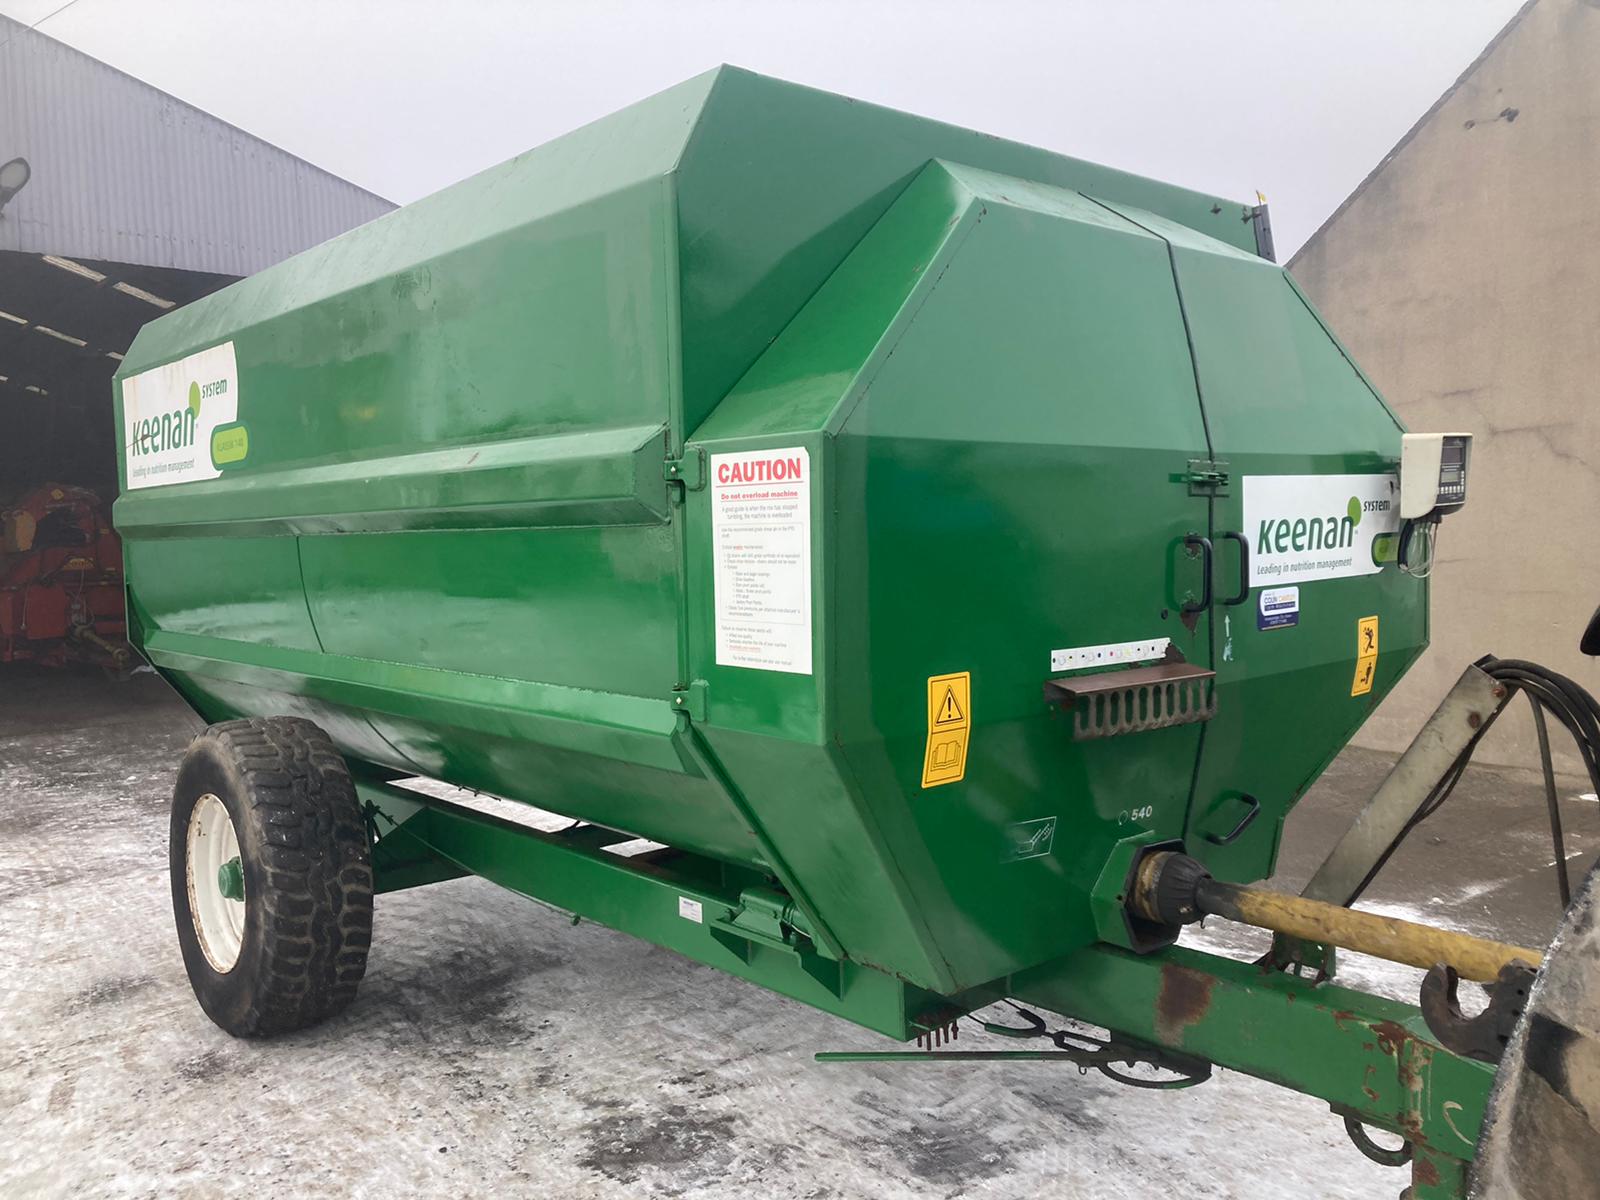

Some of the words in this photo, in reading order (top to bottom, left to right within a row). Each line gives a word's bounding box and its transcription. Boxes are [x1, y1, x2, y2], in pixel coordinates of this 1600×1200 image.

[718, 458, 801, 483] CAUTION
[721, 492, 729, 500] Do
[730, 491, 741, 499] not
[741, 490, 769, 499] overload
[770, 490, 798, 498] machine
[1257, 515, 1354, 554] Keenan
[1257, 564, 1281, 575] Leading
[1282, 564, 1289, 572] in
[1290, 560, 1315, 572] nutrition
[1316, 558, 1353, 570] management
[1130, 805, 1153, 821] 540
